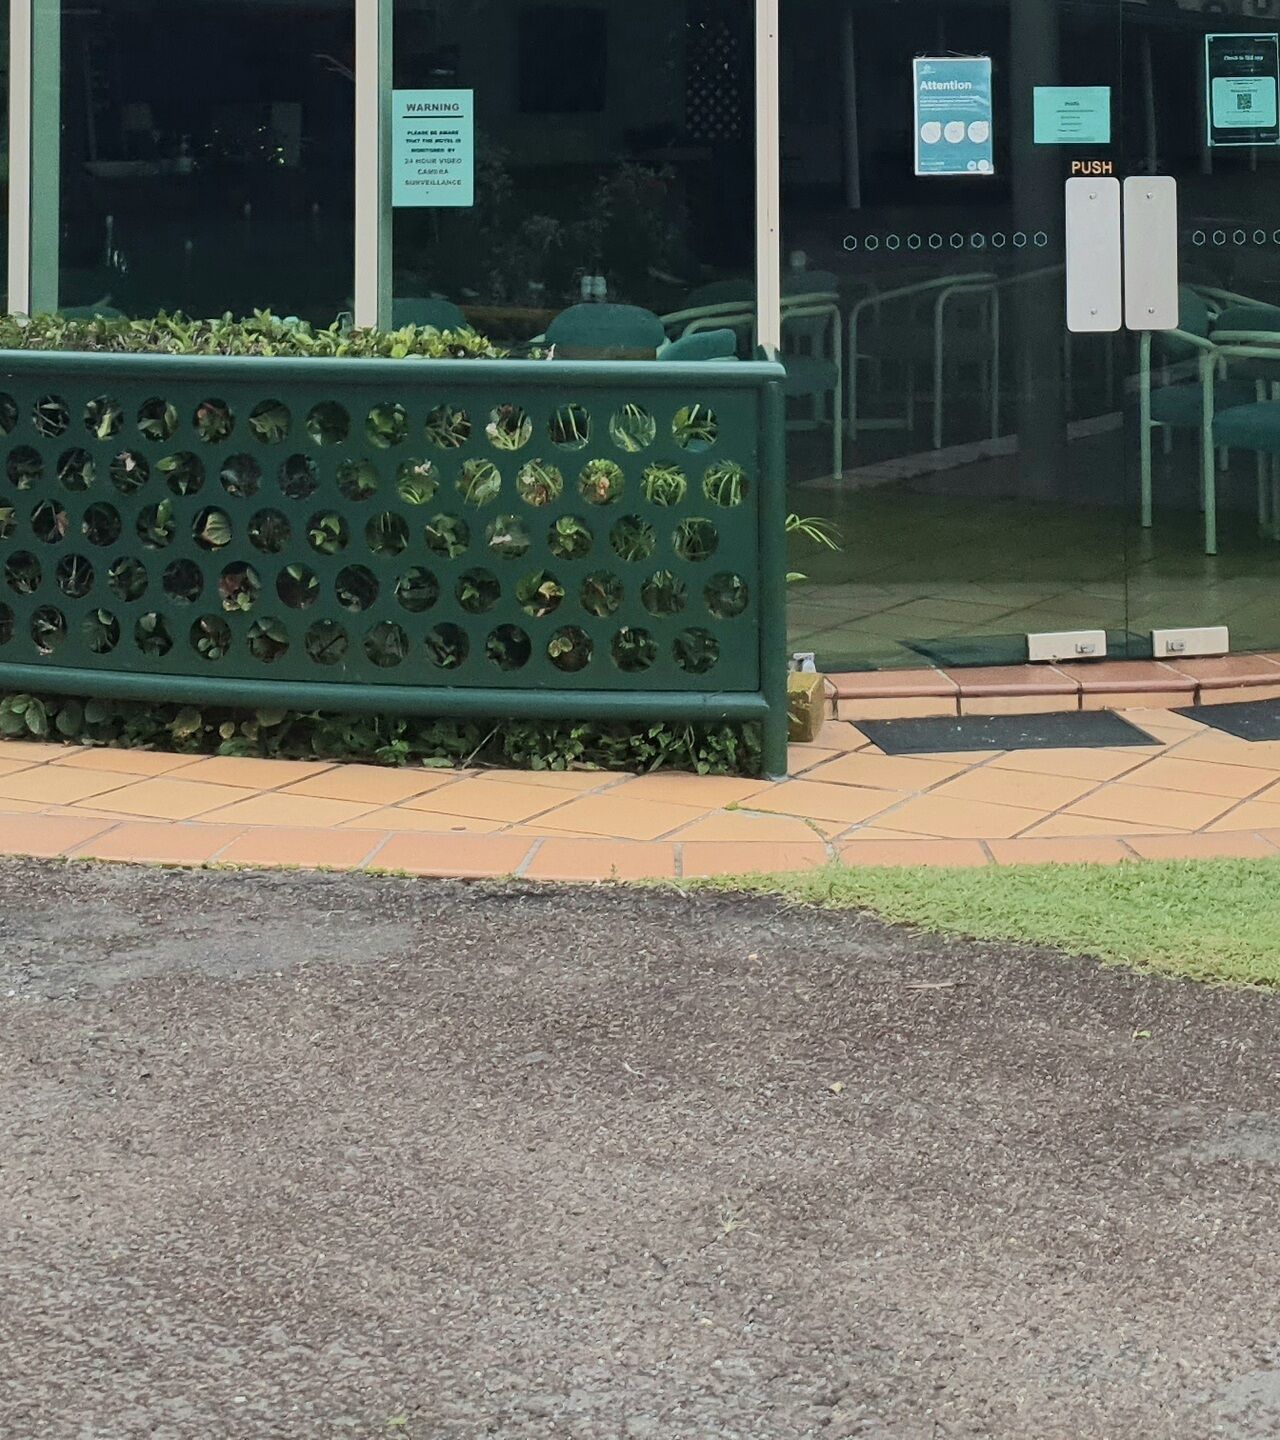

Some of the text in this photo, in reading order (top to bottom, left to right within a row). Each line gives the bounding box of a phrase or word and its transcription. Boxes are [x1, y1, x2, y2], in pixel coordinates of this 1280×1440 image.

[920, 80, 972, 90] Attention
[406, 103, 460, 111] WARNING
[1071, 161, 1112, 174] PUSH
